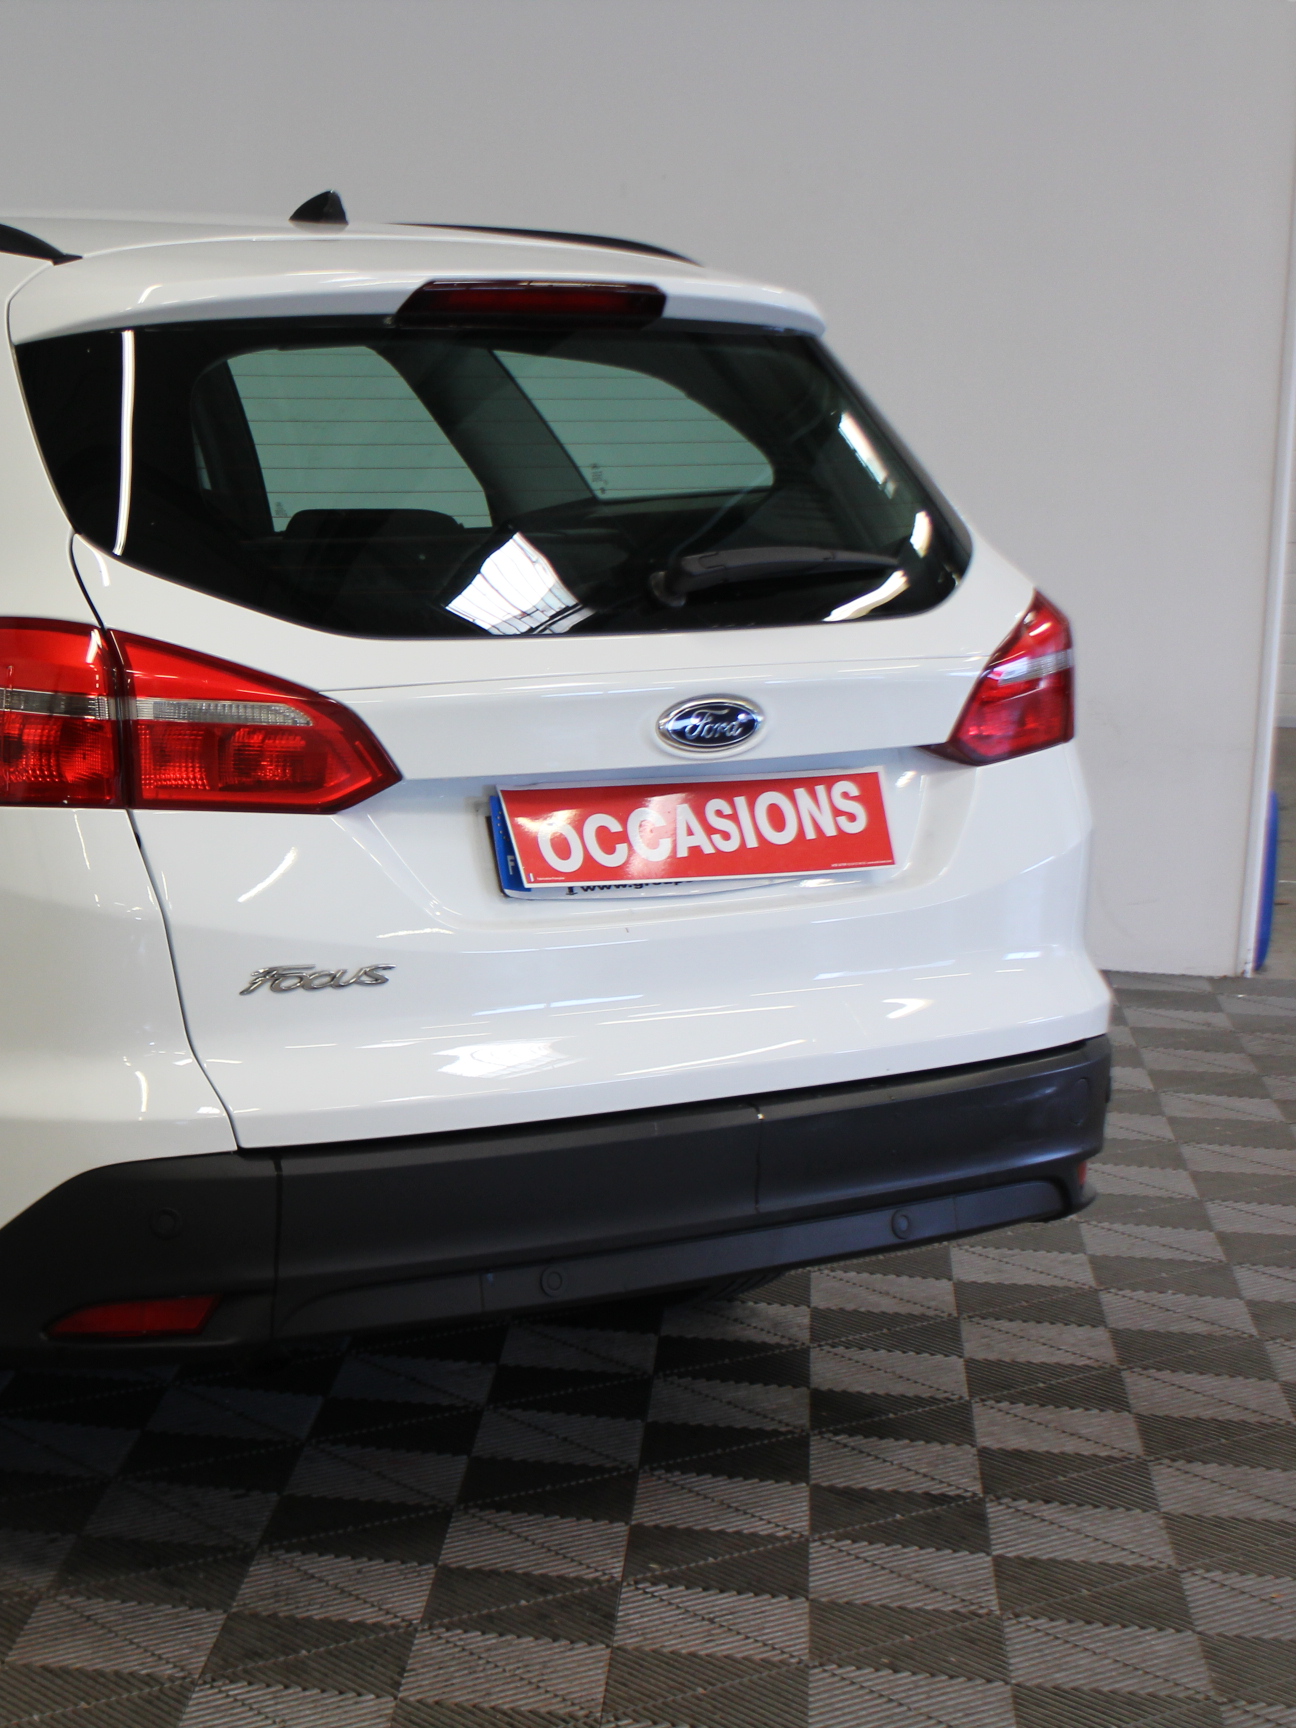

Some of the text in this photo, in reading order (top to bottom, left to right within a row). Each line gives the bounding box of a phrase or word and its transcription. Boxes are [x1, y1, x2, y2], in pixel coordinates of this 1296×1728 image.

[684, 708, 744, 740] Ford
[537, 780, 869, 873] OCCASIONS
[238, 963, 397, 997] Focus
